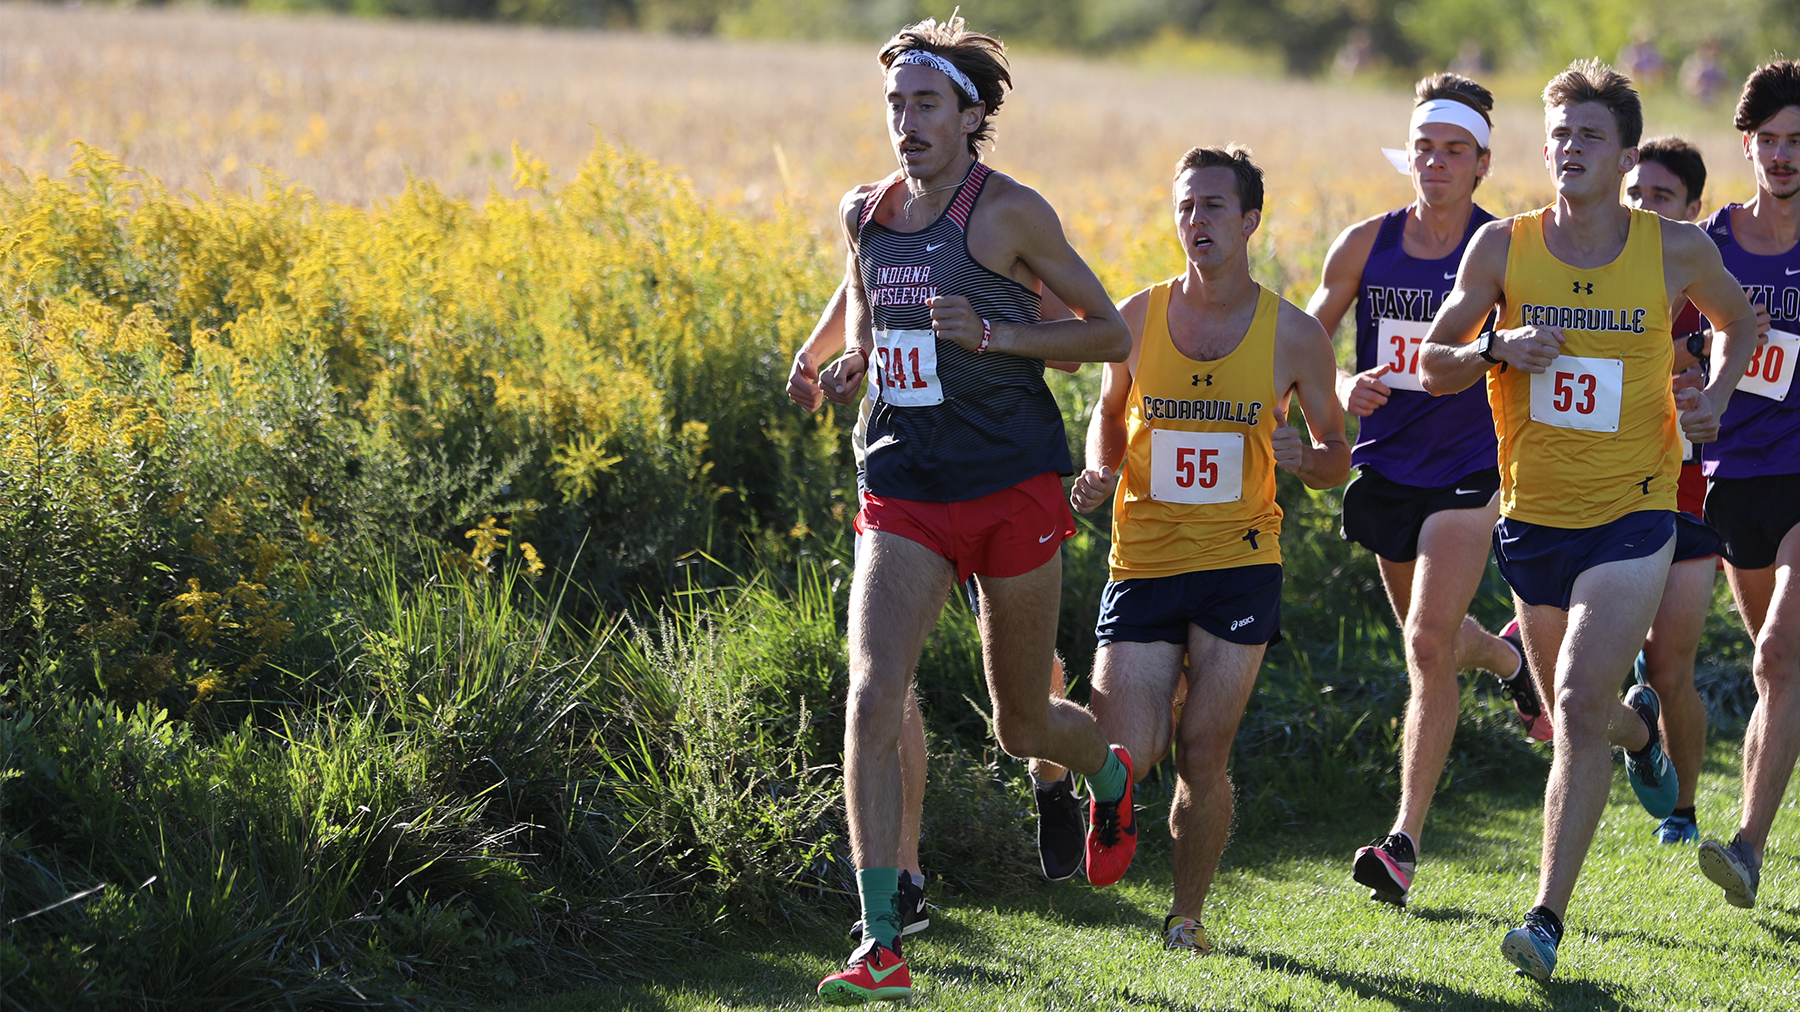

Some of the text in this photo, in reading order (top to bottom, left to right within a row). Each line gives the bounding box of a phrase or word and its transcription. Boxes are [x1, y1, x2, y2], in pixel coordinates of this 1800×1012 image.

[876, 265, 932, 285] INDIANA
[870, 286, 938, 307] WESLEYAN
[1367, 285, 1450, 322] TAYL
[1521, 303, 1646, 335] CEDARVILLE
[877, 346, 928, 390] 241
[1389, 335, 1423, 375] 37
[1142, 395, 1262, 427] CEDARVILLE
[1553, 371, 1597, 415] 53
[1175, 447, 1219, 489] 55
